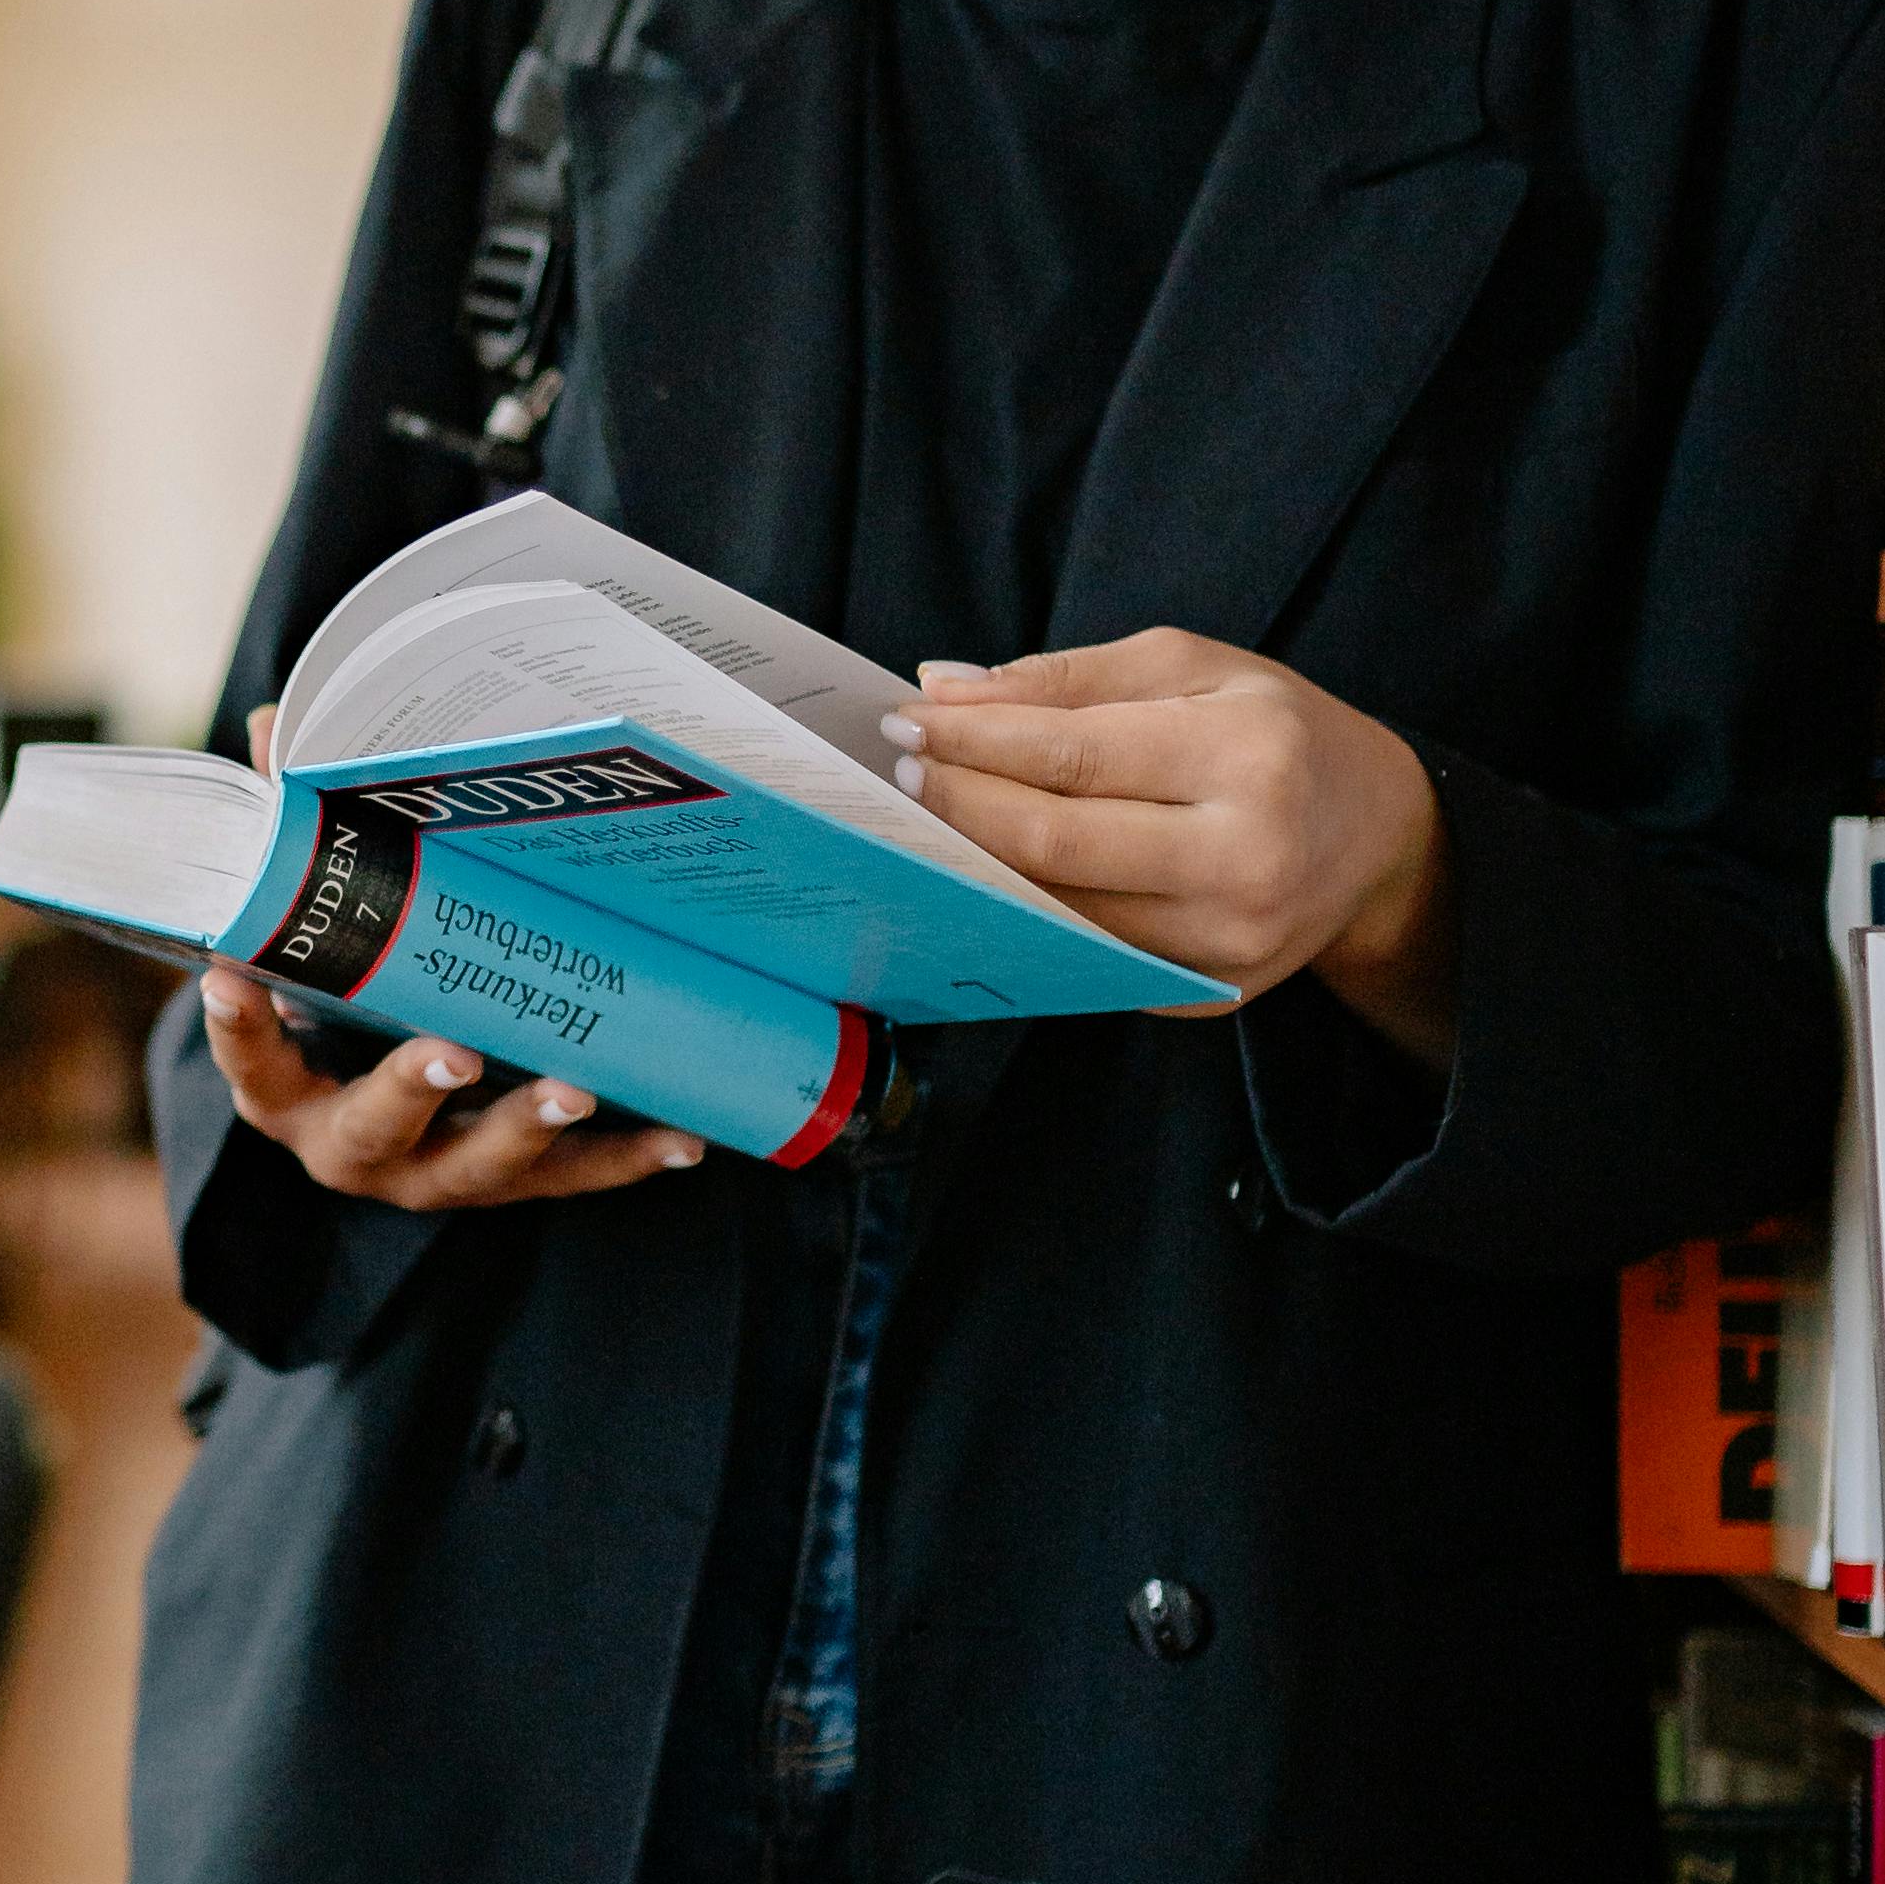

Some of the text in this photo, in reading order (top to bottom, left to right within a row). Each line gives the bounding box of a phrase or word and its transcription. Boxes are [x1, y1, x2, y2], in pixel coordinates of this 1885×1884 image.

[359, 758, 682, 823] DUDEN
[484, 813, 745, 853] Das Herkunfts-
[557, 836, 759, 868] wörterbuch
[282, 823, 359, 963] DUDEN
[356, 902, 381, 923] 7
[436, 893, 626, 995] wörterbuch
[414, 947, 604, 1046] Herkunfts-
